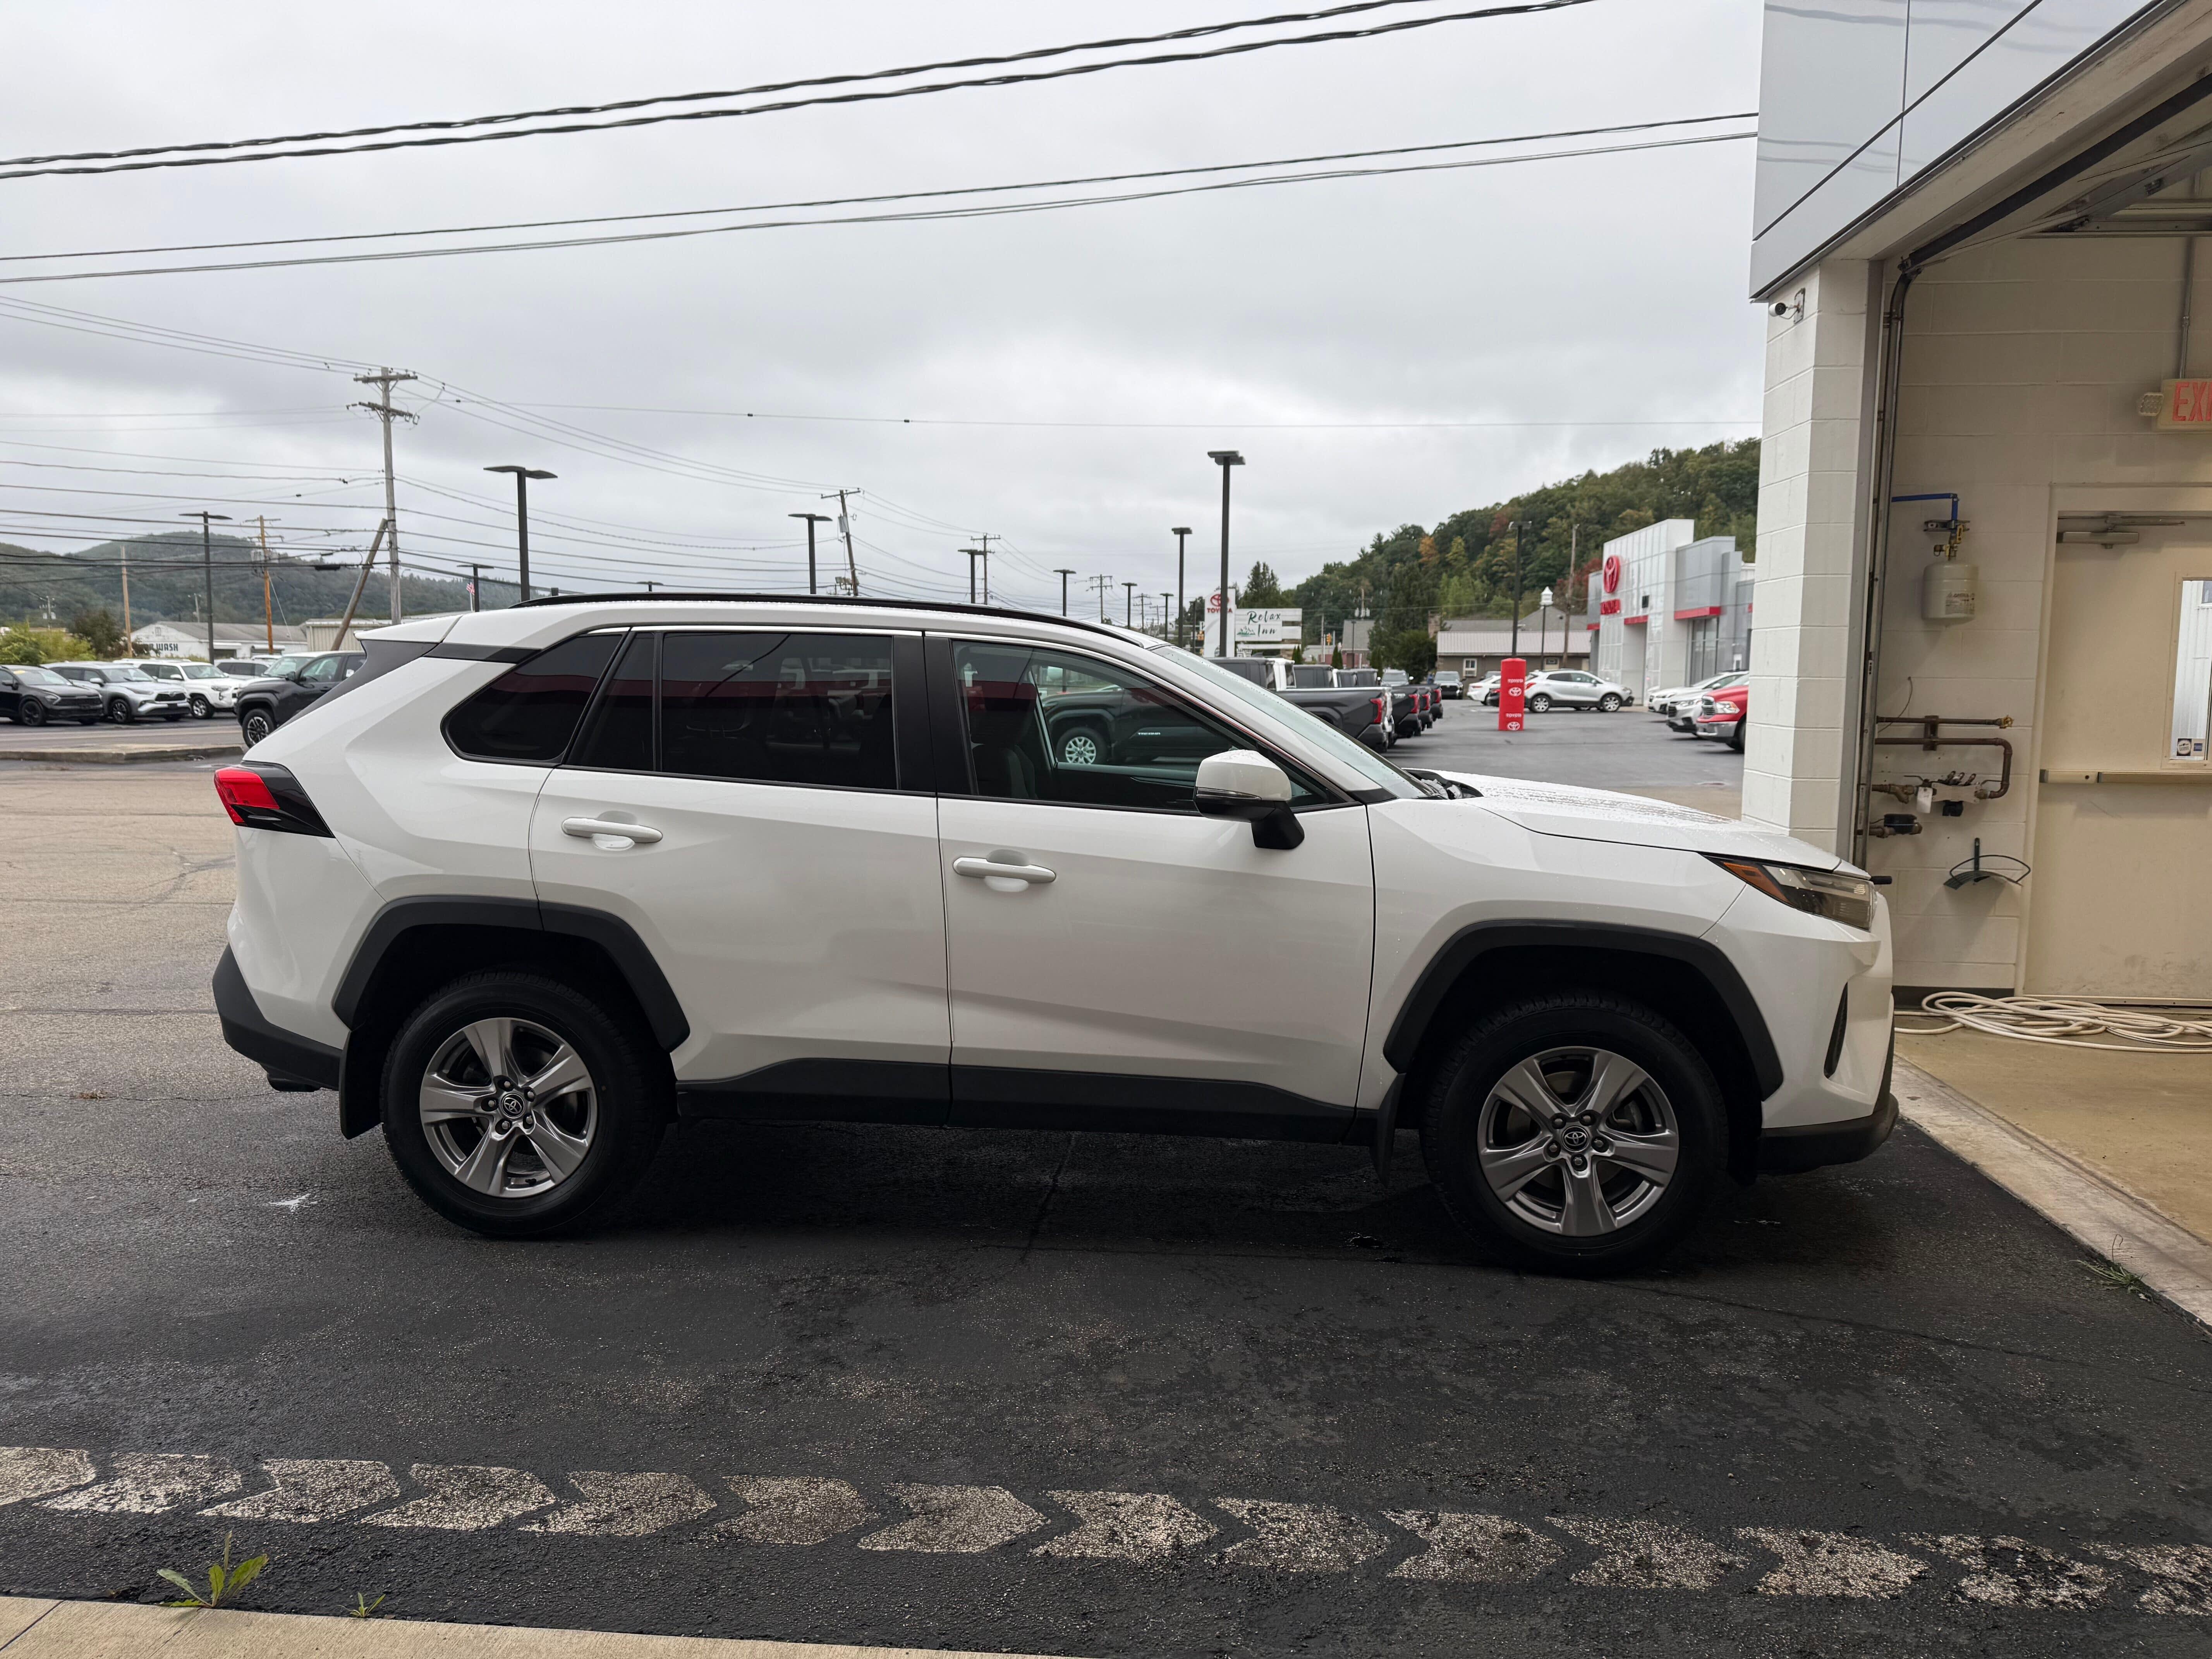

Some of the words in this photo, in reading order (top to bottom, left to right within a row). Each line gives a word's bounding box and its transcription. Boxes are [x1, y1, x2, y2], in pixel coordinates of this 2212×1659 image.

[1247, 611, 1281, 624] Relax
[1258, 624, 1277, 637] Inn
[156, 643, 178, 651] WASH
